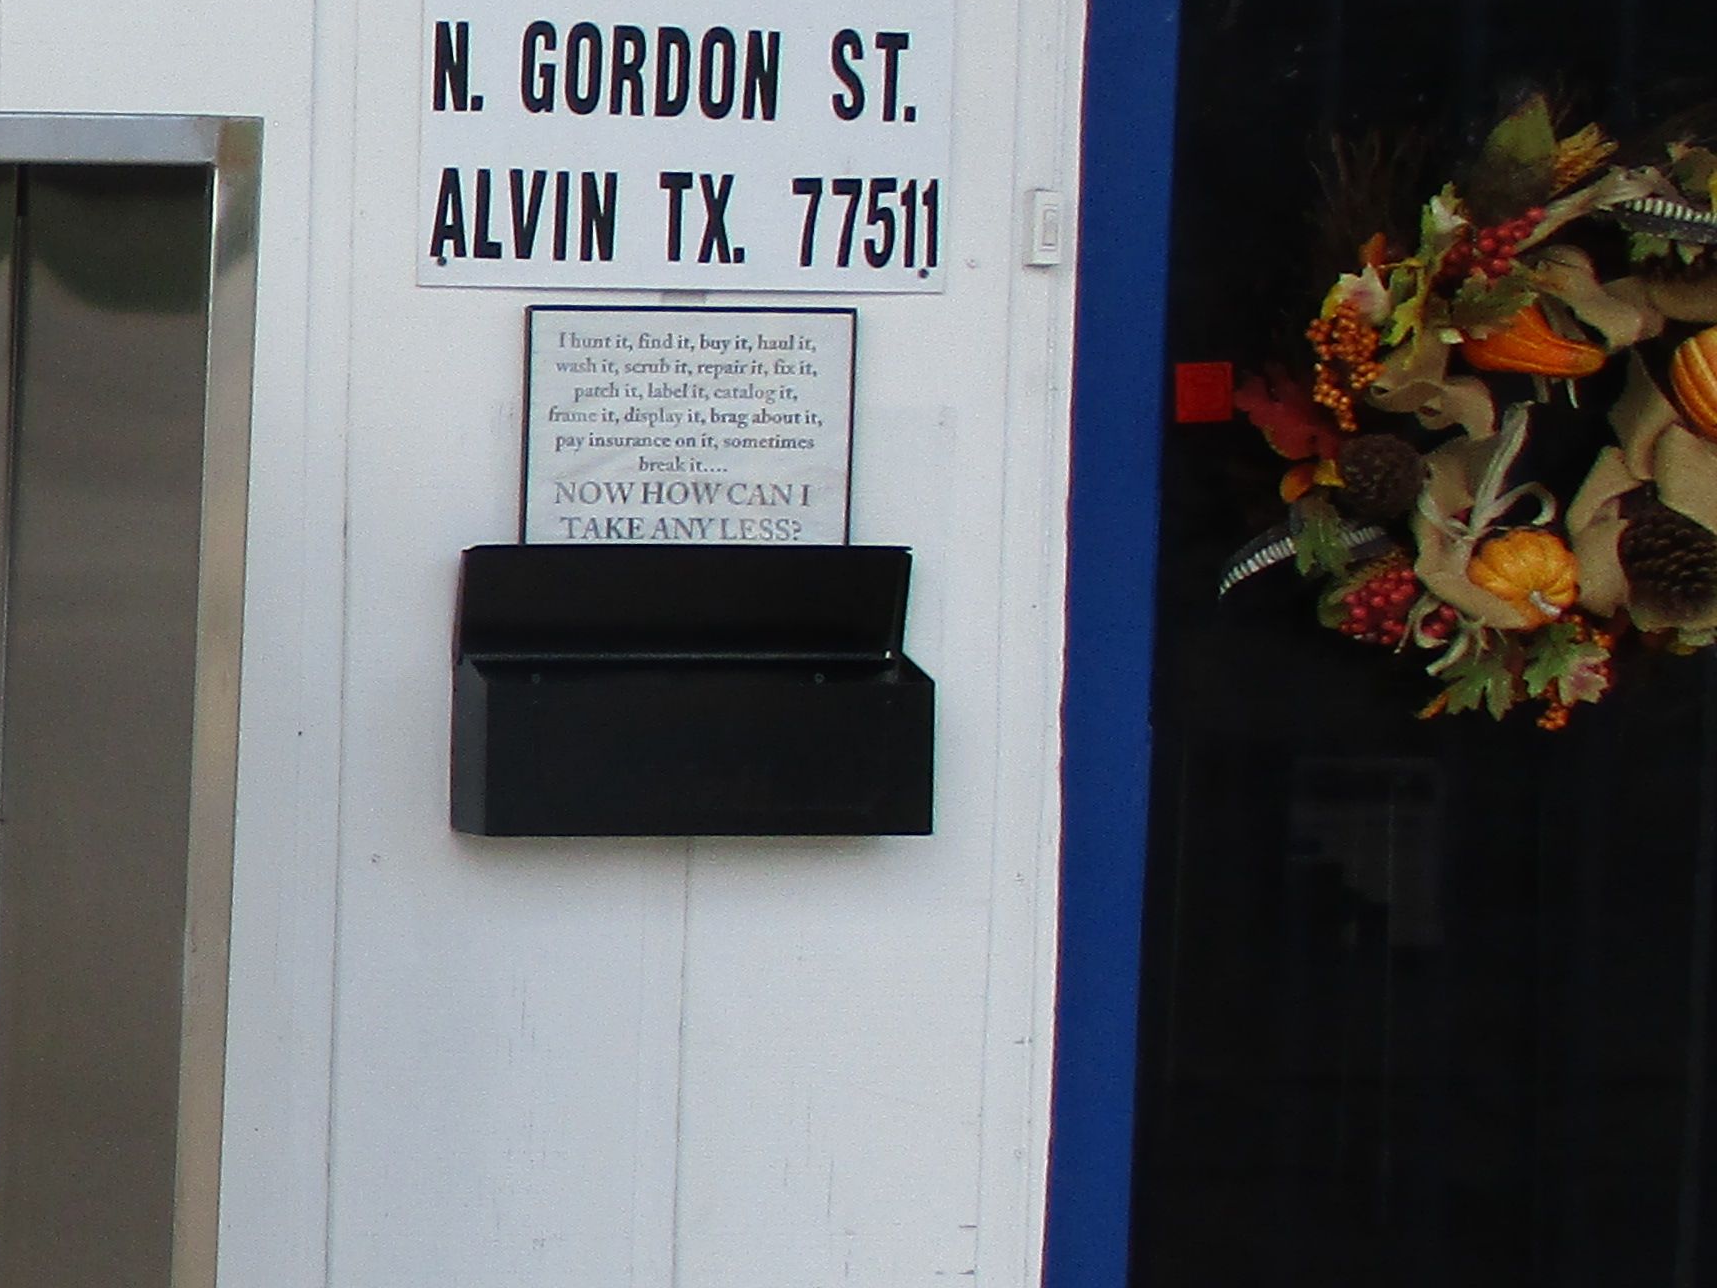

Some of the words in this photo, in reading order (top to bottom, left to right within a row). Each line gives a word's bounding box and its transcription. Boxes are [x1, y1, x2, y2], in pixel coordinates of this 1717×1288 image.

[434, 22, 483, 111] N.
[522, 21, 779, 120] GORDON
[832, 29, 915, 122] ST.
[430, 168, 617, 260] ALVIN
[660, 172, 744, 263] TX.
[793, 178, 938, 269] 77511
[559, 332, 566, 348] I
[571, 332, 612, 348] hunt
[638, 332, 673, 349] find
[677, 335, 695, 352] it,
[700, 333, 730, 354] buy
[735, 335, 752, 353] it,
[757, 334, 794, 350] haul
[798, 336, 816, 353] it,
[556, 357, 596, 373] wash
[601, 359, 619, 376] it,
[625, 358, 670, 373] scrub
[675, 360, 693, 376] it,
[697, 360, 748, 379] repair
[751, 360, 768, 377] it,
[773, 358, 796, 375] fix
[799, 360, 817, 377] it,
[574, 382, 619, 403] patch
[625, 383, 643, 400] it,
[648, 383, 688, 398] label
[692, 384, 710, 401] it,
[713, 384, 776, 404] catalog
[779, 385, 798, 402] it,
[548, 406, 597, 422] frame
[601, 407, 619, 425] it,
[623, 407, 683, 428] display
[688, 409, 706, 425] it,
[710, 408, 749, 429] brag
[752, 408, 801, 423] about
[804, 410, 822, 427] it,
[555, 435, 584, 452] pay
[589, 432, 671, 447] insurance
[675, 436, 696, 447] on
[723, 435, 815, 449] sometimes
[639, 456, 686, 471] break
[553, 481, 635, 505] NOW
[642, 482, 722, 505] HOW
[726, 482, 793, 506] CAN
[800, 484, 812, 507] I
[559, 517, 644, 539] TAKE
[650, 518, 715, 539] ANY
[720, 518, 802, 541] LESS?
